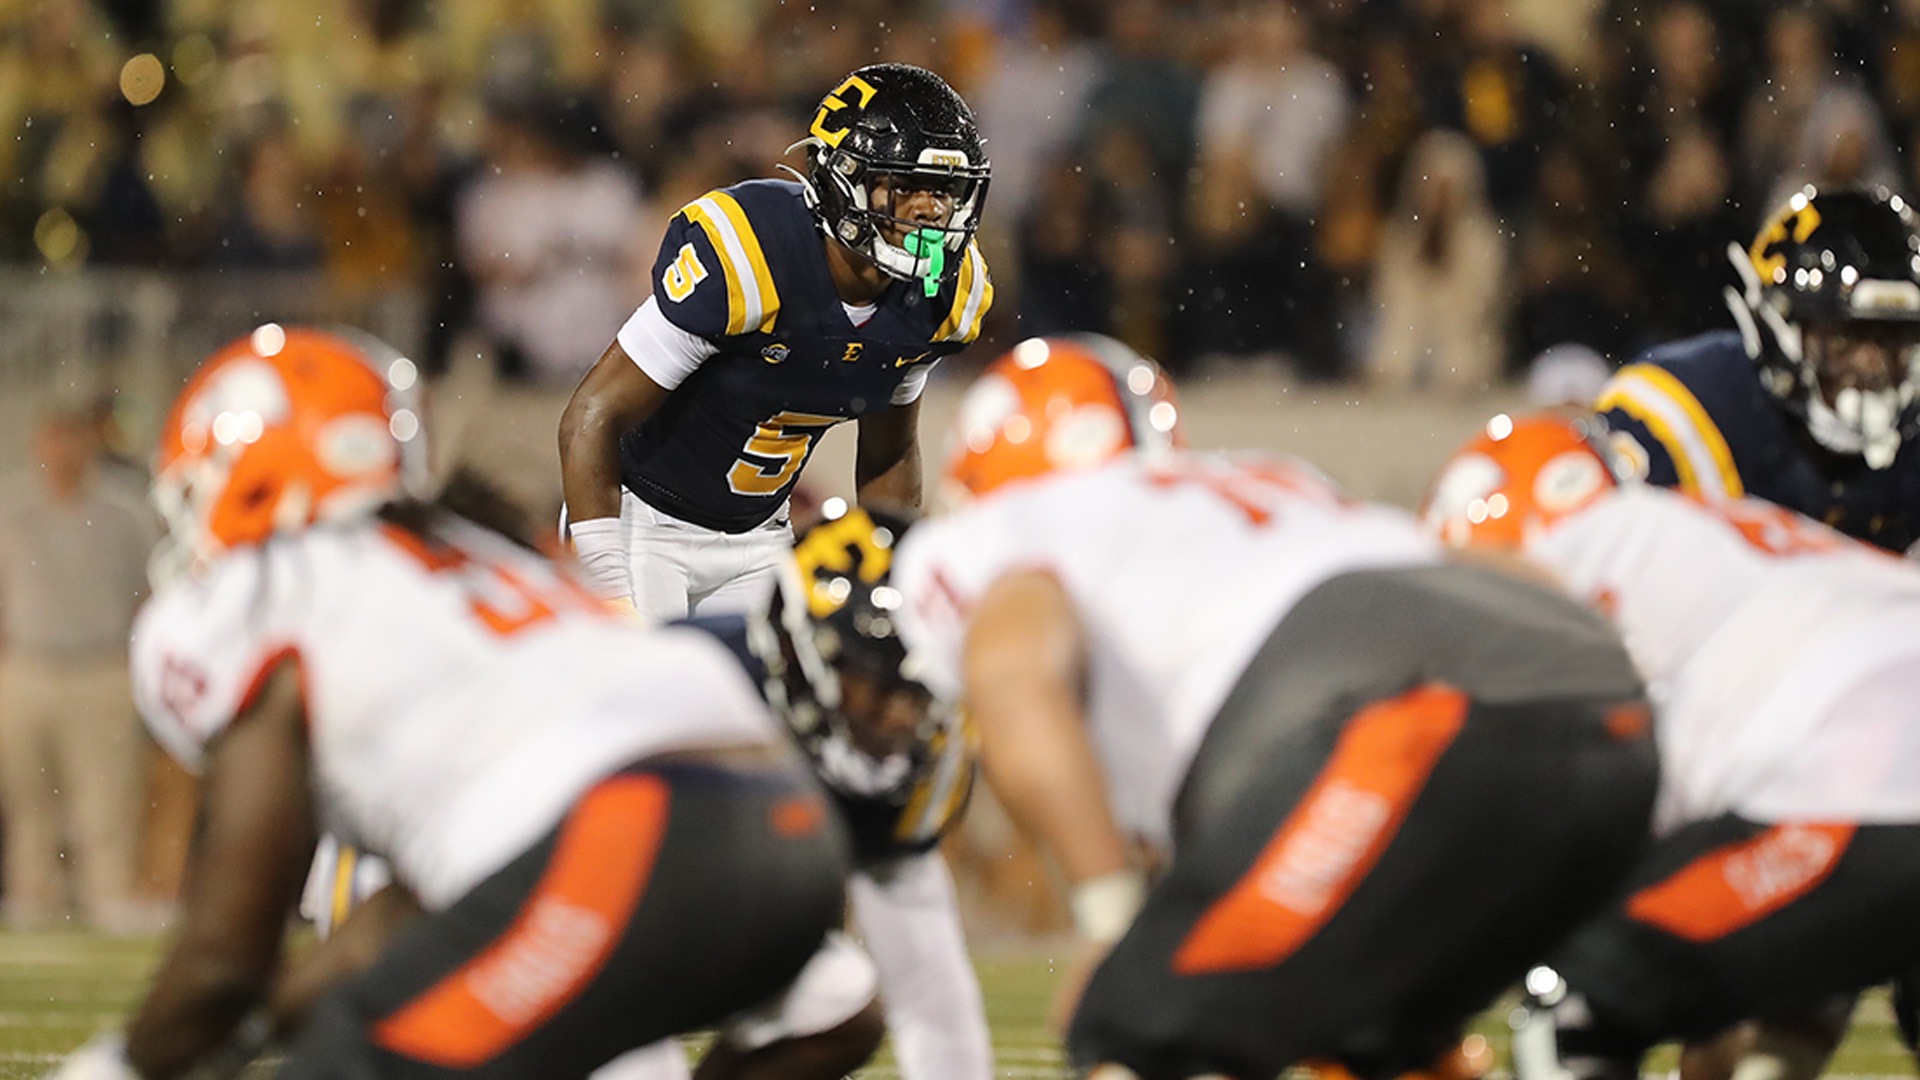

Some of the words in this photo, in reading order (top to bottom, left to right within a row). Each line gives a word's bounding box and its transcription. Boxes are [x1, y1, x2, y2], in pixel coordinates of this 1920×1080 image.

[809, 74, 878, 149] E
[661, 242, 709, 303] 5
[842, 342, 863, 362] E
[726, 411, 851, 496] 5
